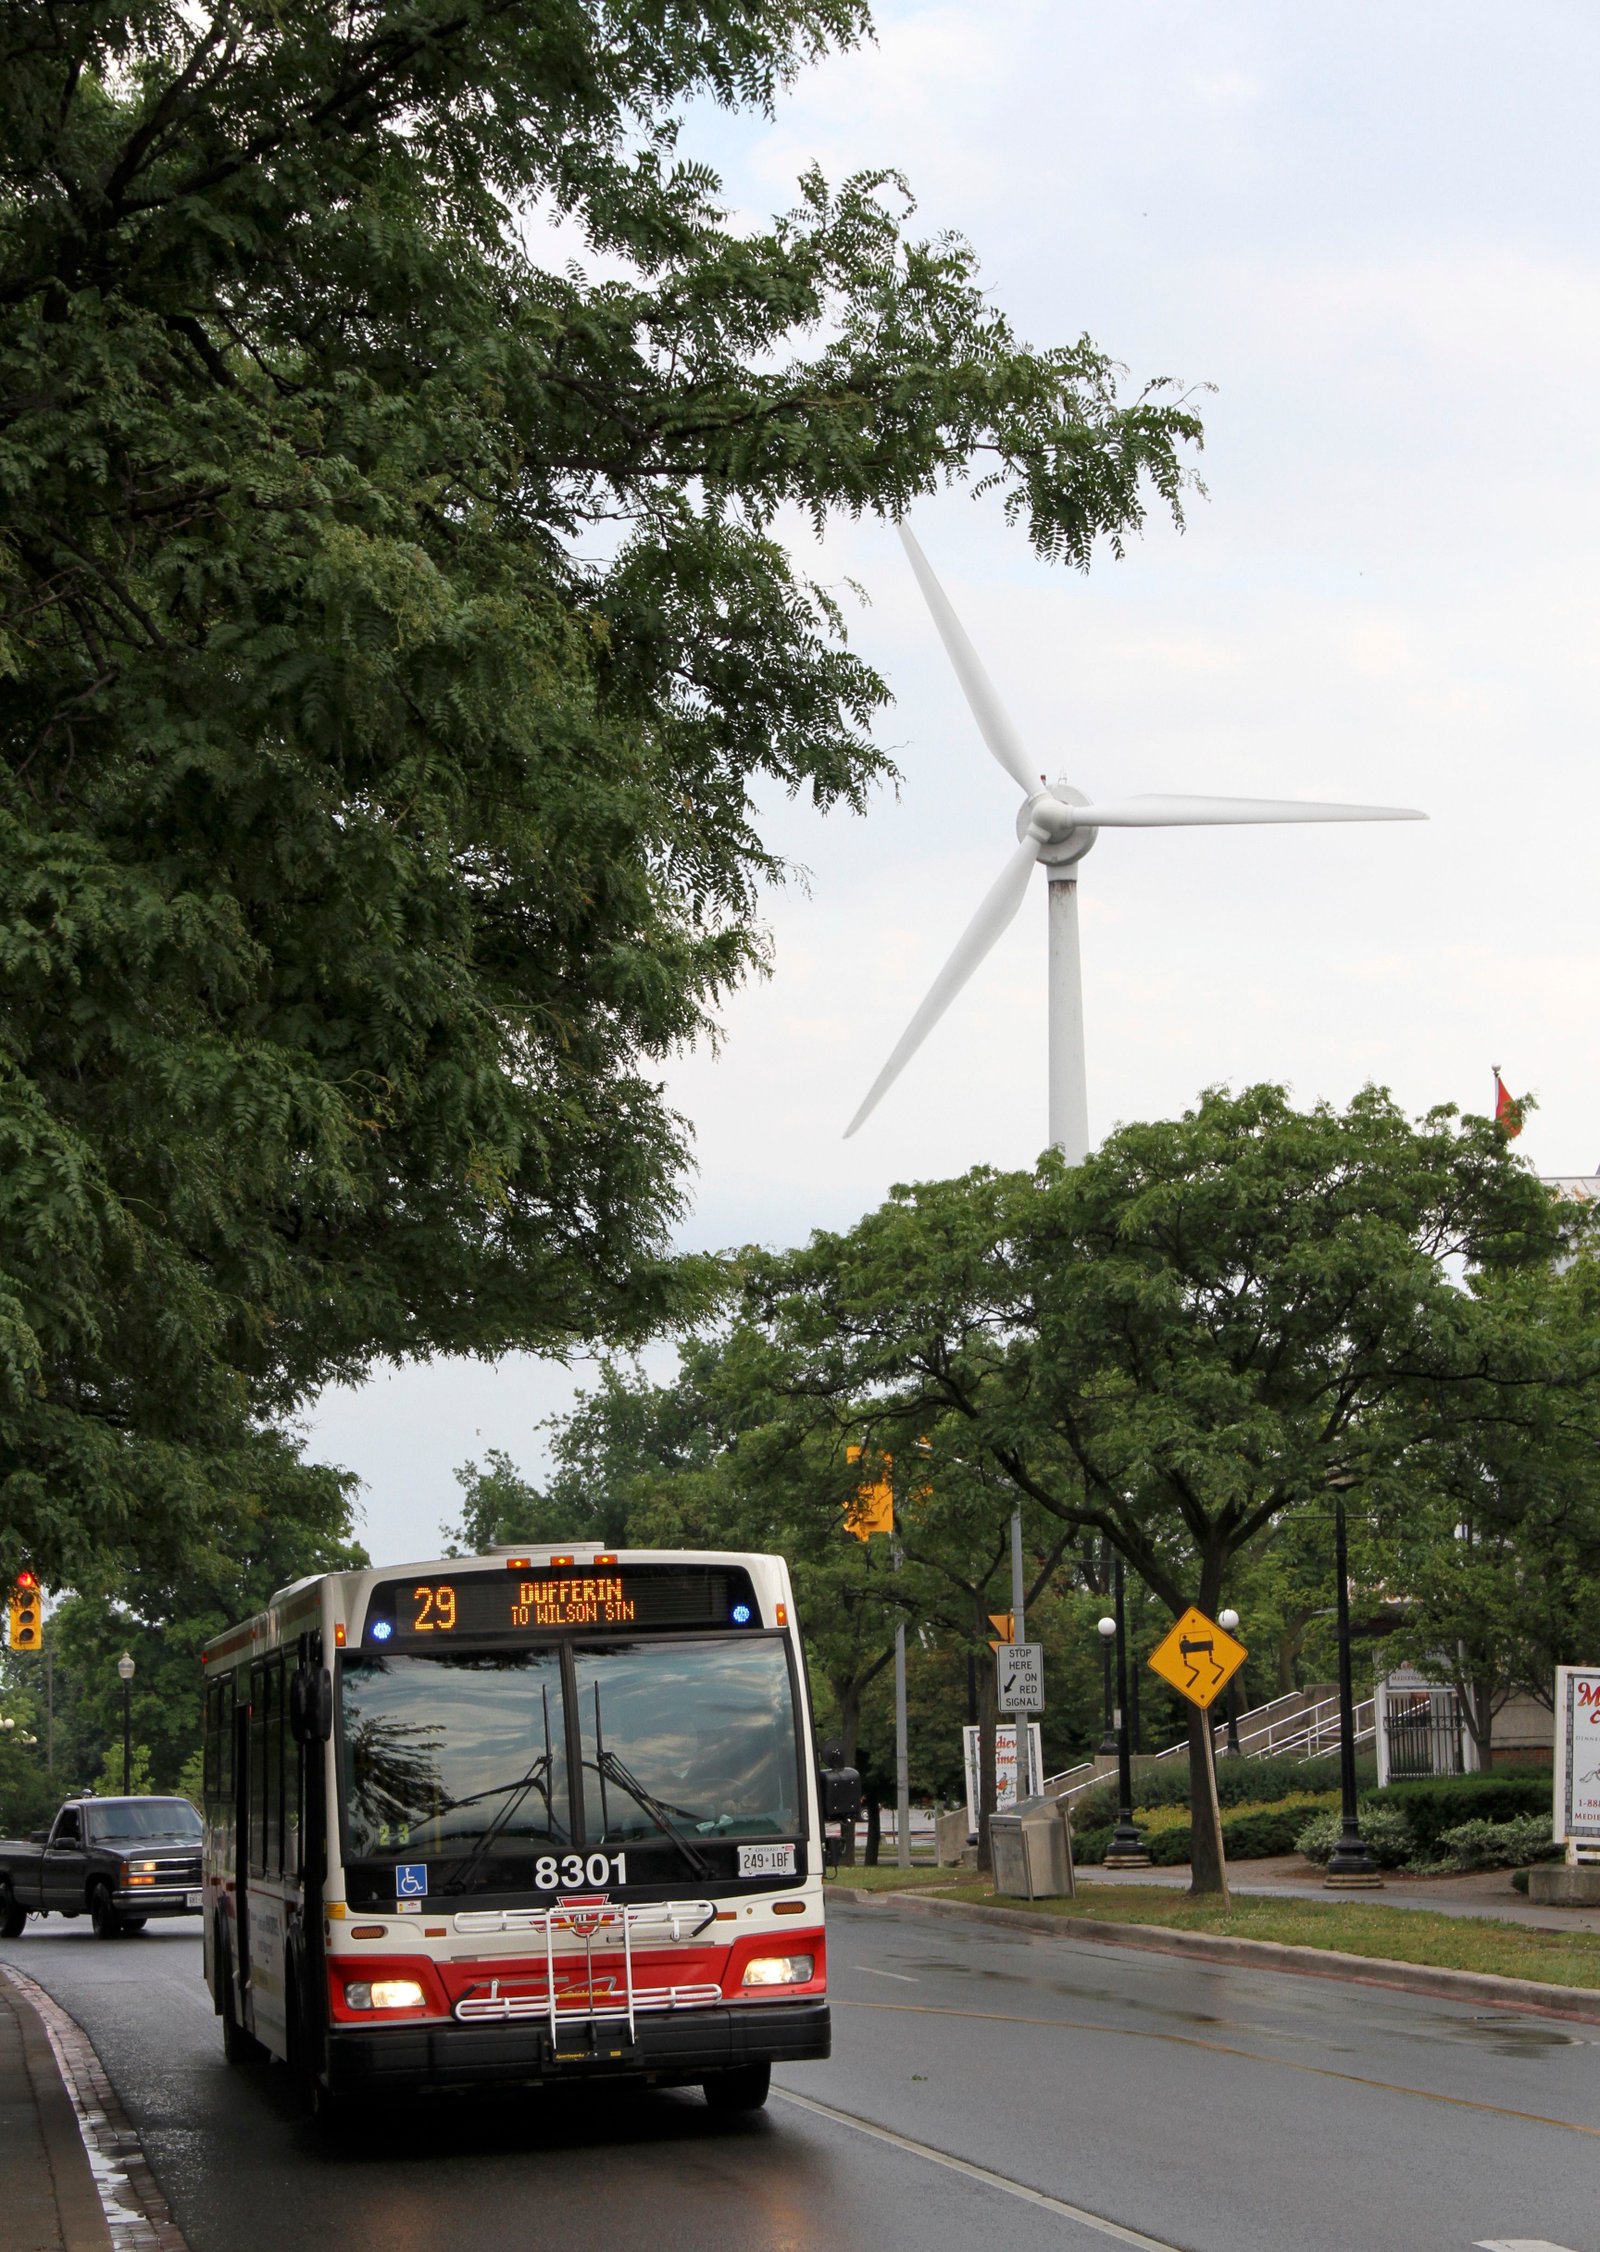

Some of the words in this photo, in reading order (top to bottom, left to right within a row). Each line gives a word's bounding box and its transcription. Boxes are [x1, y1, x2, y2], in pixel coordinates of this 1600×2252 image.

[520, 1578, 622, 1604] DUFFERIN
[414, 1586, 455, 1630] 29
[511, 1606, 529, 1625] TO
[536, 1603, 597, 1624] WILSON
[605, 1601, 634, 1621] STN
[1009, 1649, 1032, 1658] STOP
[1009, 1661, 1032, 1670] HERE
[1025, 1673, 1037, 1681] ON
[1020, 1685, 1038, 1694] RED
[1006, 1698, 1038, 1707] SIGNAL
[535, 1852, 626, 1889] 8301
